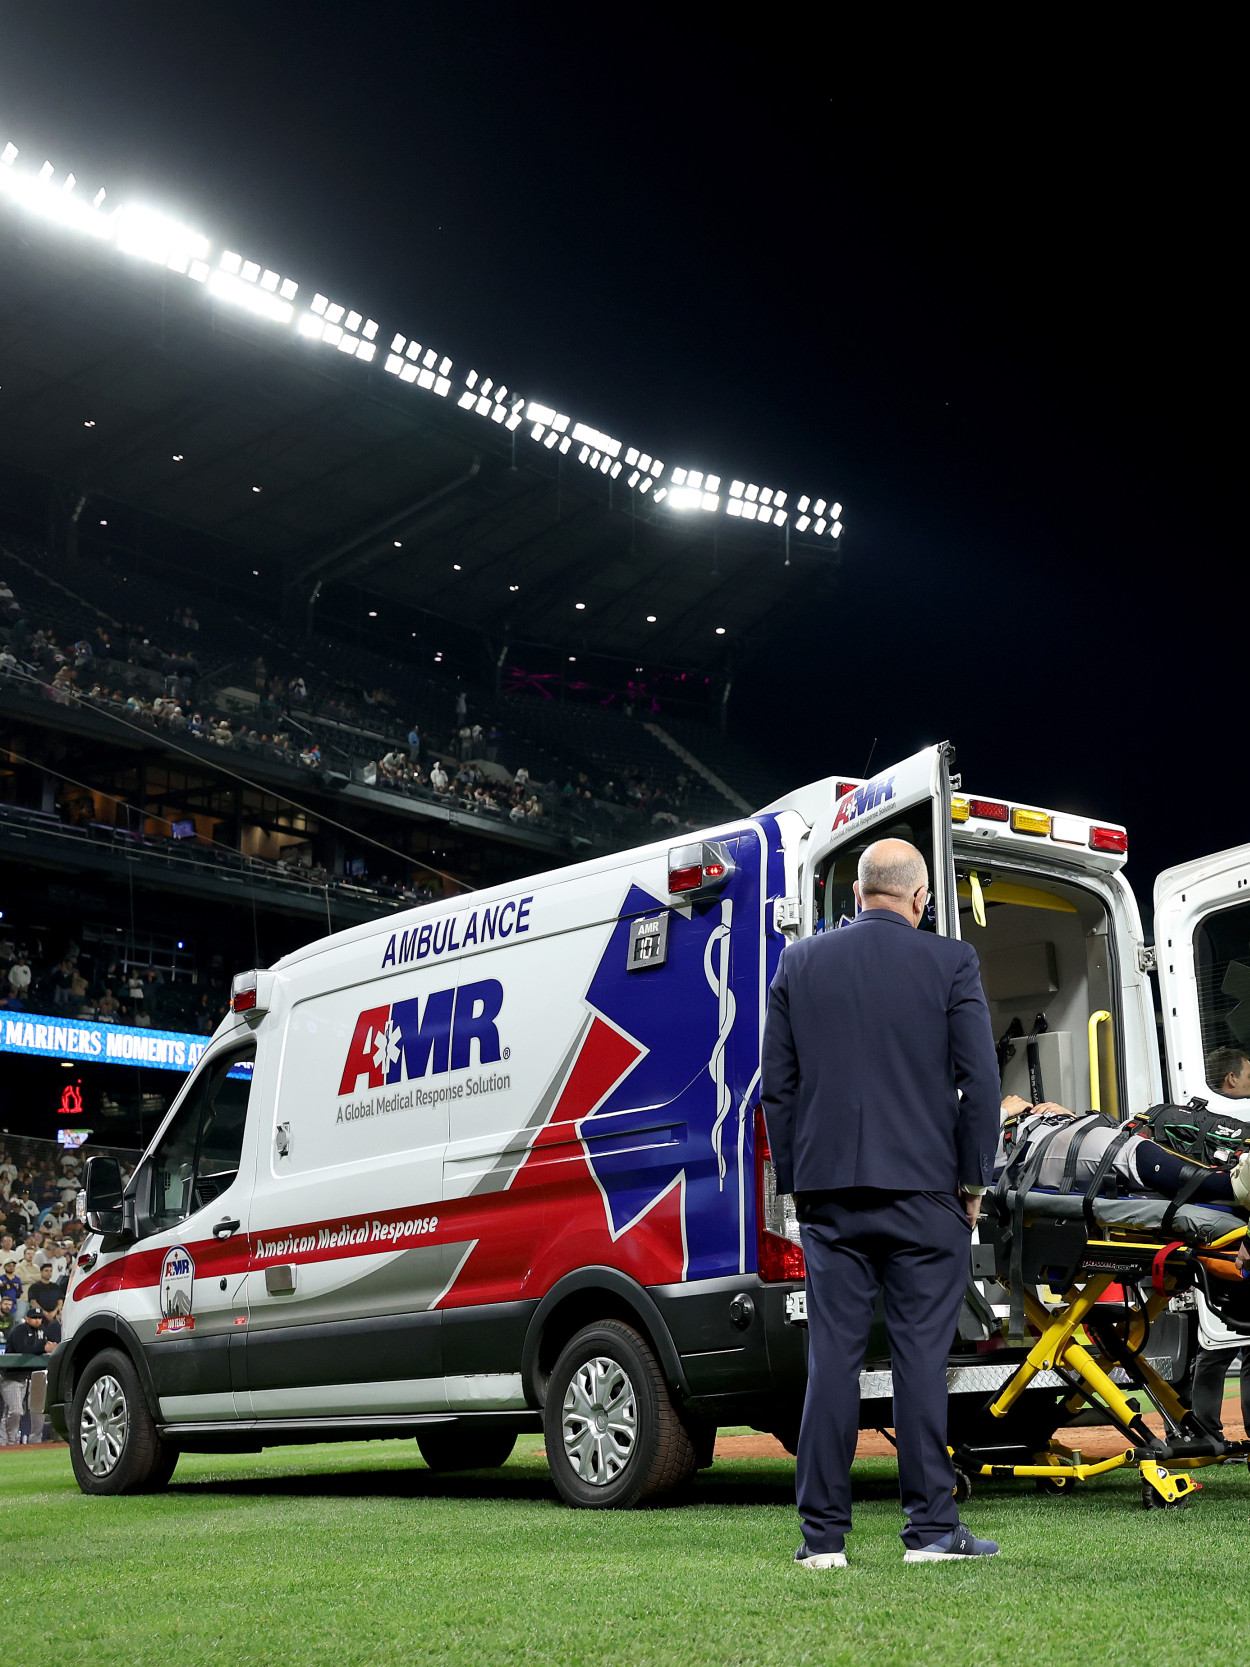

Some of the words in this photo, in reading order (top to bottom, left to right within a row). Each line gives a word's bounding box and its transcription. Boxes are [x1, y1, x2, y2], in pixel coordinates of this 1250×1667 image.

[381, 896, 534, 969] AMBULANCE
[638, 921, 659, 935] AMR
[6, 1020, 102, 1055] MARINERS
[106, 1032, 186, 1064] MOMENTS
[336, 1107, 344, 1123] A
[344, 1102, 374, 1121] Global
[376, 1091, 413, 1115] Medical
[416, 1084, 463, 1108] Response
[466, 1073, 511, 1096] Solution
[255, 1233, 316, 1260] American
[317, 1221, 370, 1250] Medical
[370, 1216, 439, 1244] Response
[165, 1259, 190, 1278] AMR
[175, 1317, 186, 1328] YEARS
